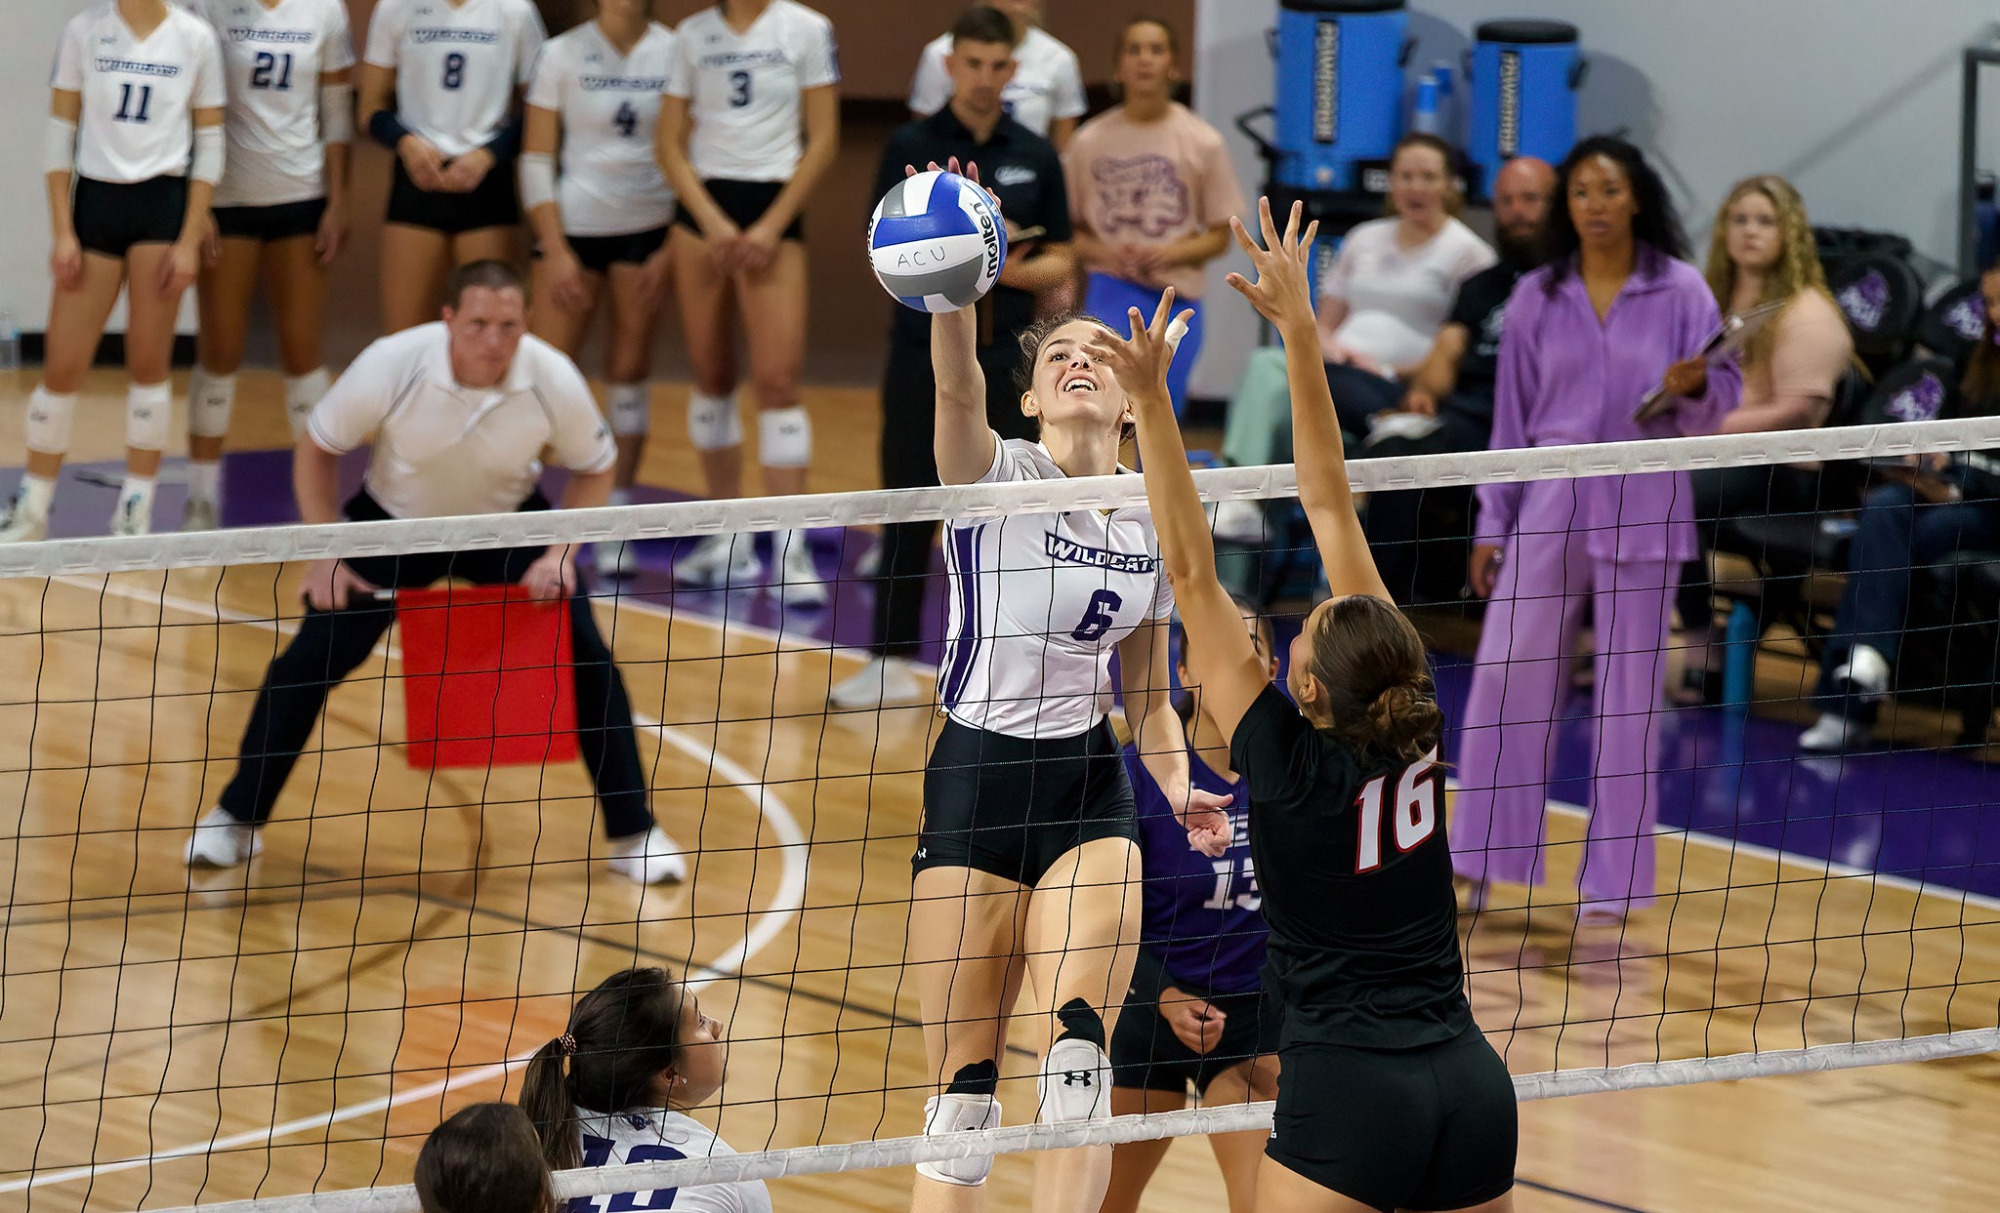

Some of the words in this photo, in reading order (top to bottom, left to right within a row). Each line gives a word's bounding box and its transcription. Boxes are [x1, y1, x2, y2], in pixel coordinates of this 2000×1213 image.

[250, 51, 293, 90] 21
[443, 52, 467, 90] 8
[730, 70, 751, 108] 3
[113, 83, 151, 123] 11
[614, 101, 638, 137] 4
[897, 246, 946, 268] ACU
[973, 201, 998, 279] molten
[1070, 588, 1123, 641] 6
[1353, 744, 1438, 875] 16
